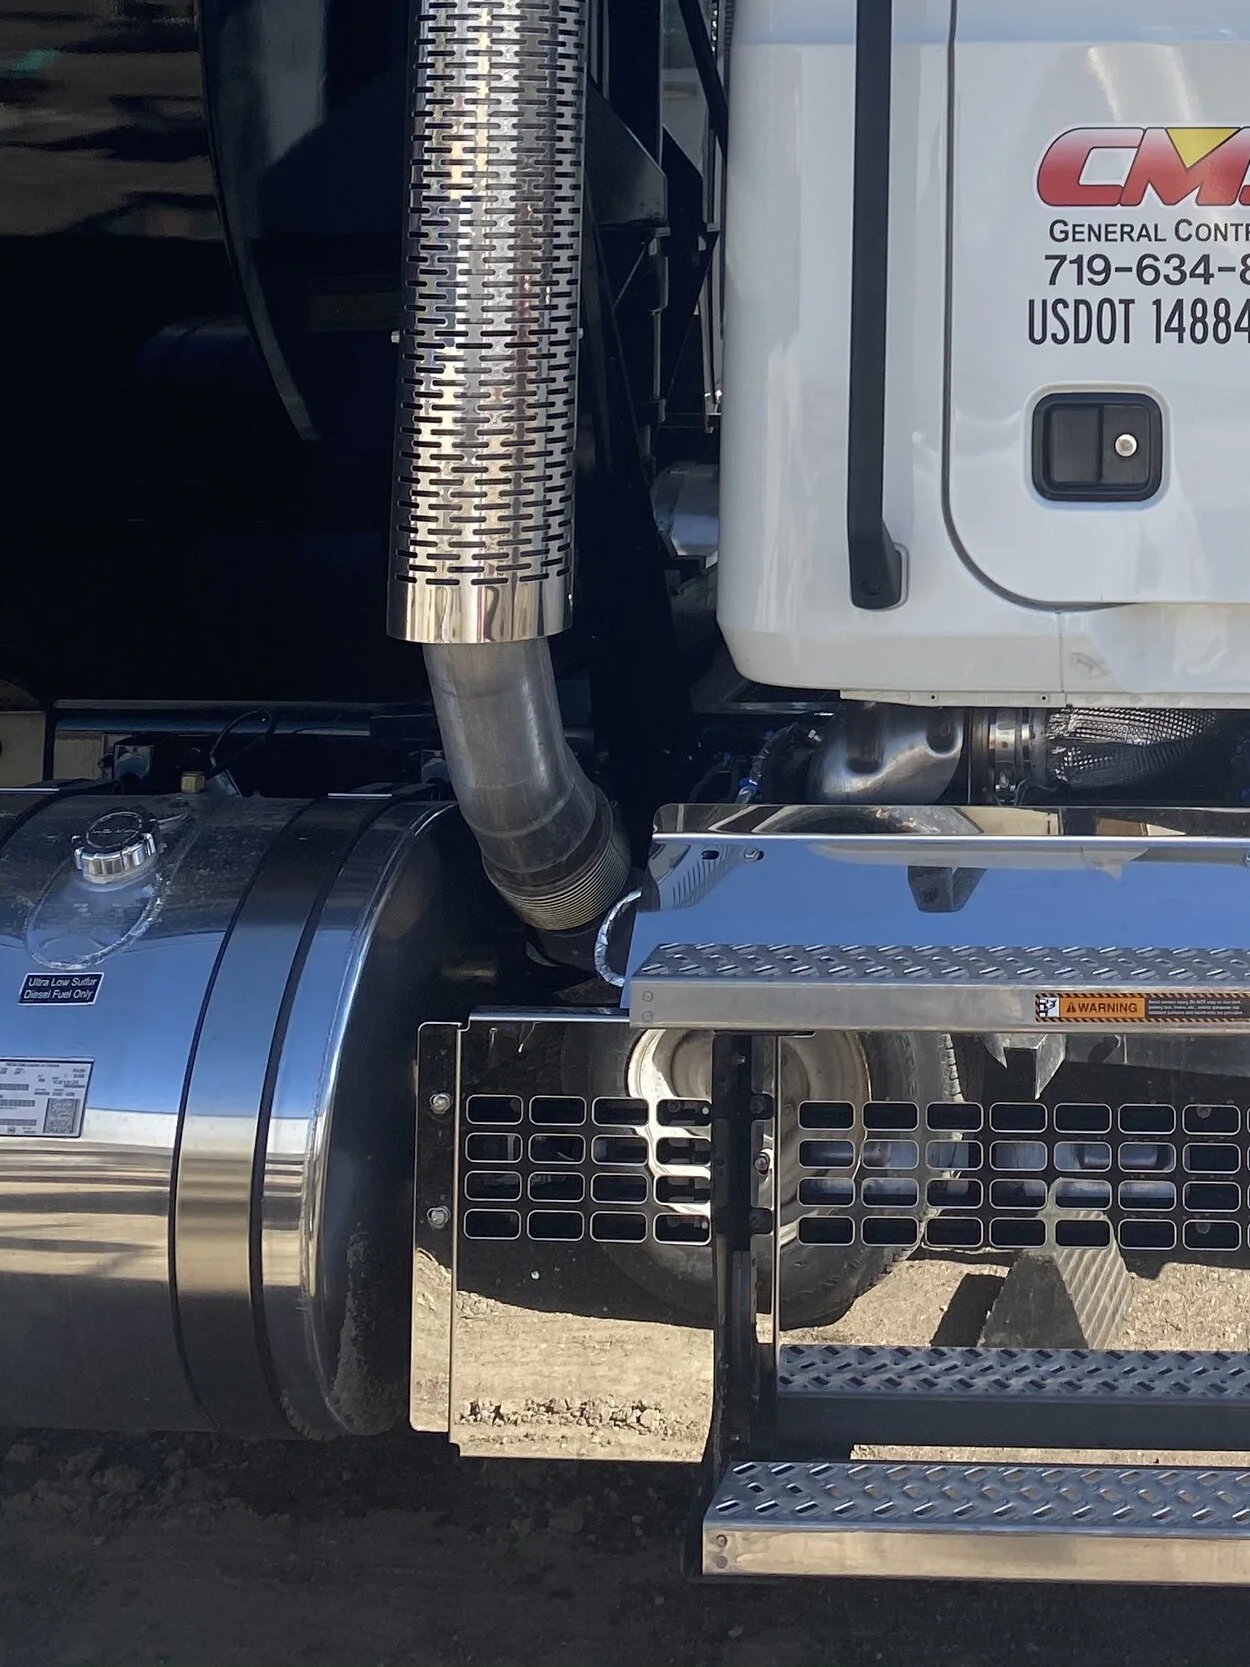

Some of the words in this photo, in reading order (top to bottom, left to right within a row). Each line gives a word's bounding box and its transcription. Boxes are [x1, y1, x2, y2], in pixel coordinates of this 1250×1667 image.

[1049, 219, 1167, 242] GENERAL
[1028, 297, 1135, 345] USDOT
[28, 977, 50, 987] Ultra
[51, 977, 70, 987] Low
[23, 989, 51, 999] Diesel
[52, 989, 73, 999] Fuel
[73, 989, 94, 1001] Only
[1078, 1002, 1138, 1013] WARNING
